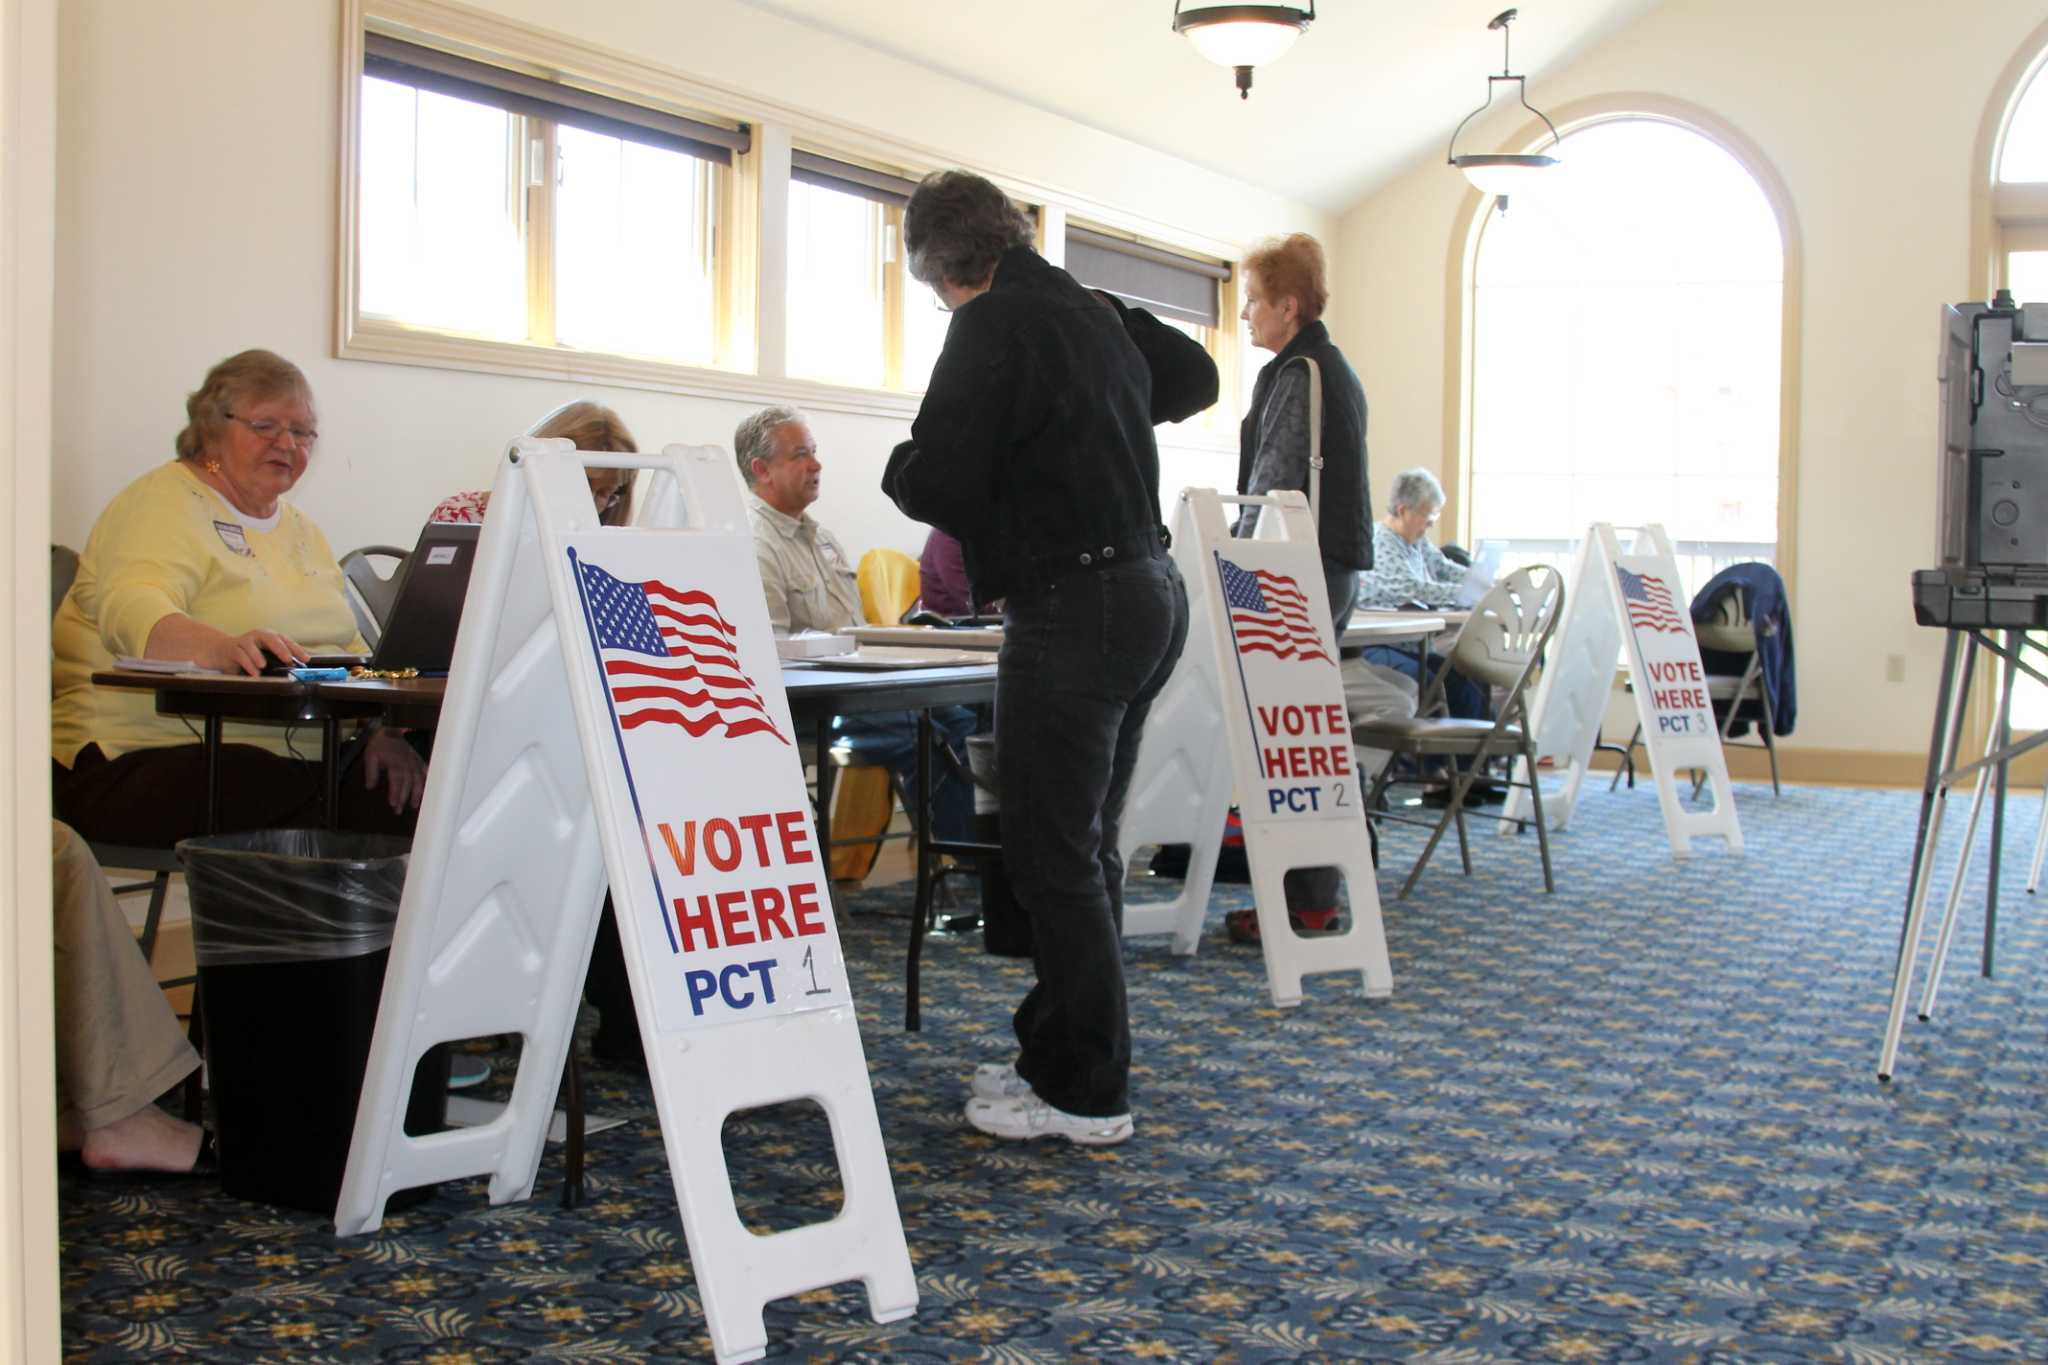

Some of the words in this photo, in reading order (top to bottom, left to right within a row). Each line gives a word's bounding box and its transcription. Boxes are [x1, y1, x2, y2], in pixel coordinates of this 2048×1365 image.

[1648, 661, 1702, 683] VOTE
[1654, 688, 1706, 709] HERE
[1257, 704, 1346, 736] VOTE
[1658, 715, 1690, 732] PCT
[1696, 712, 1709, 732] 3
[1263, 745, 1351, 779] HERE
[1268, 786, 1322, 814] PCT
[1332, 782, 1351, 807] 2
[657, 810, 814, 877] VOTE
[673, 882, 826, 953] HERE
[684, 958, 778, 1017] PCT
[802, 944, 832, 996] 1
